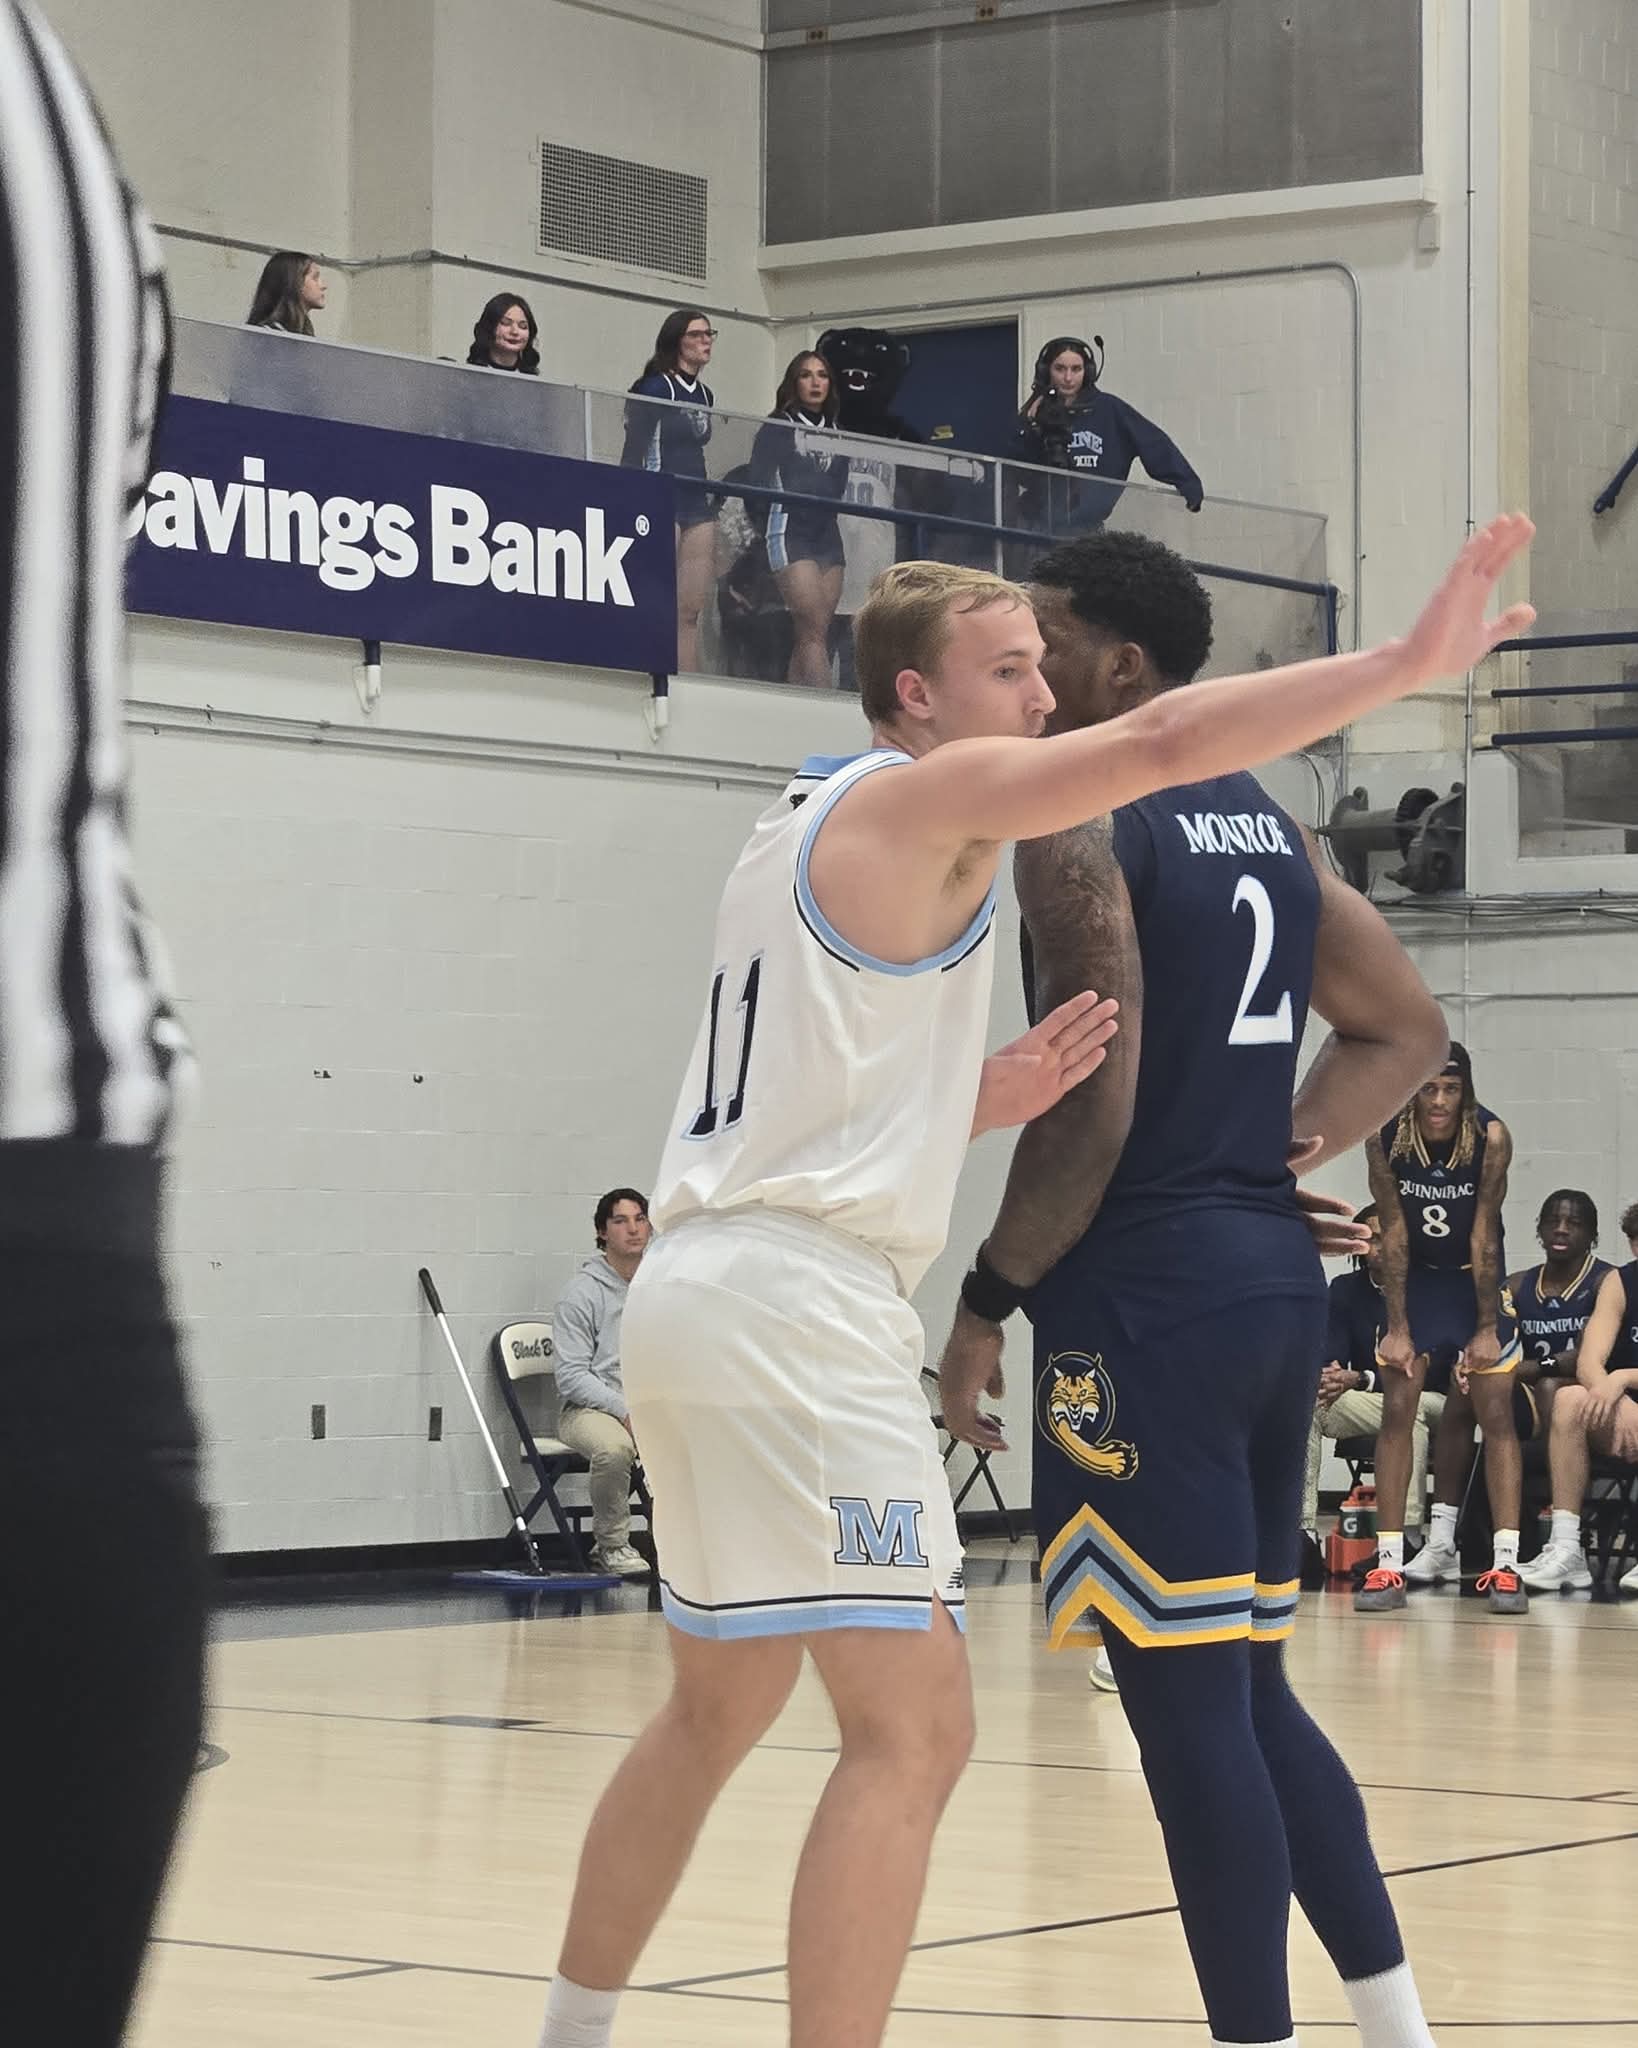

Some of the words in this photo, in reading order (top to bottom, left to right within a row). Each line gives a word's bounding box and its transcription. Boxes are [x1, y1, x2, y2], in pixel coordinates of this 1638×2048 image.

[122, 456, 419, 591] avings
[1175, 812, 1293, 855] MONROE
[1228, 873, 1293, 1045] 2
[680, 949, 764, 1141] 11
[1422, 1204, 1451, 1238] 8
[829, 1496, 929, 1568] M
[1343, 1517, 1358, 1534] G
